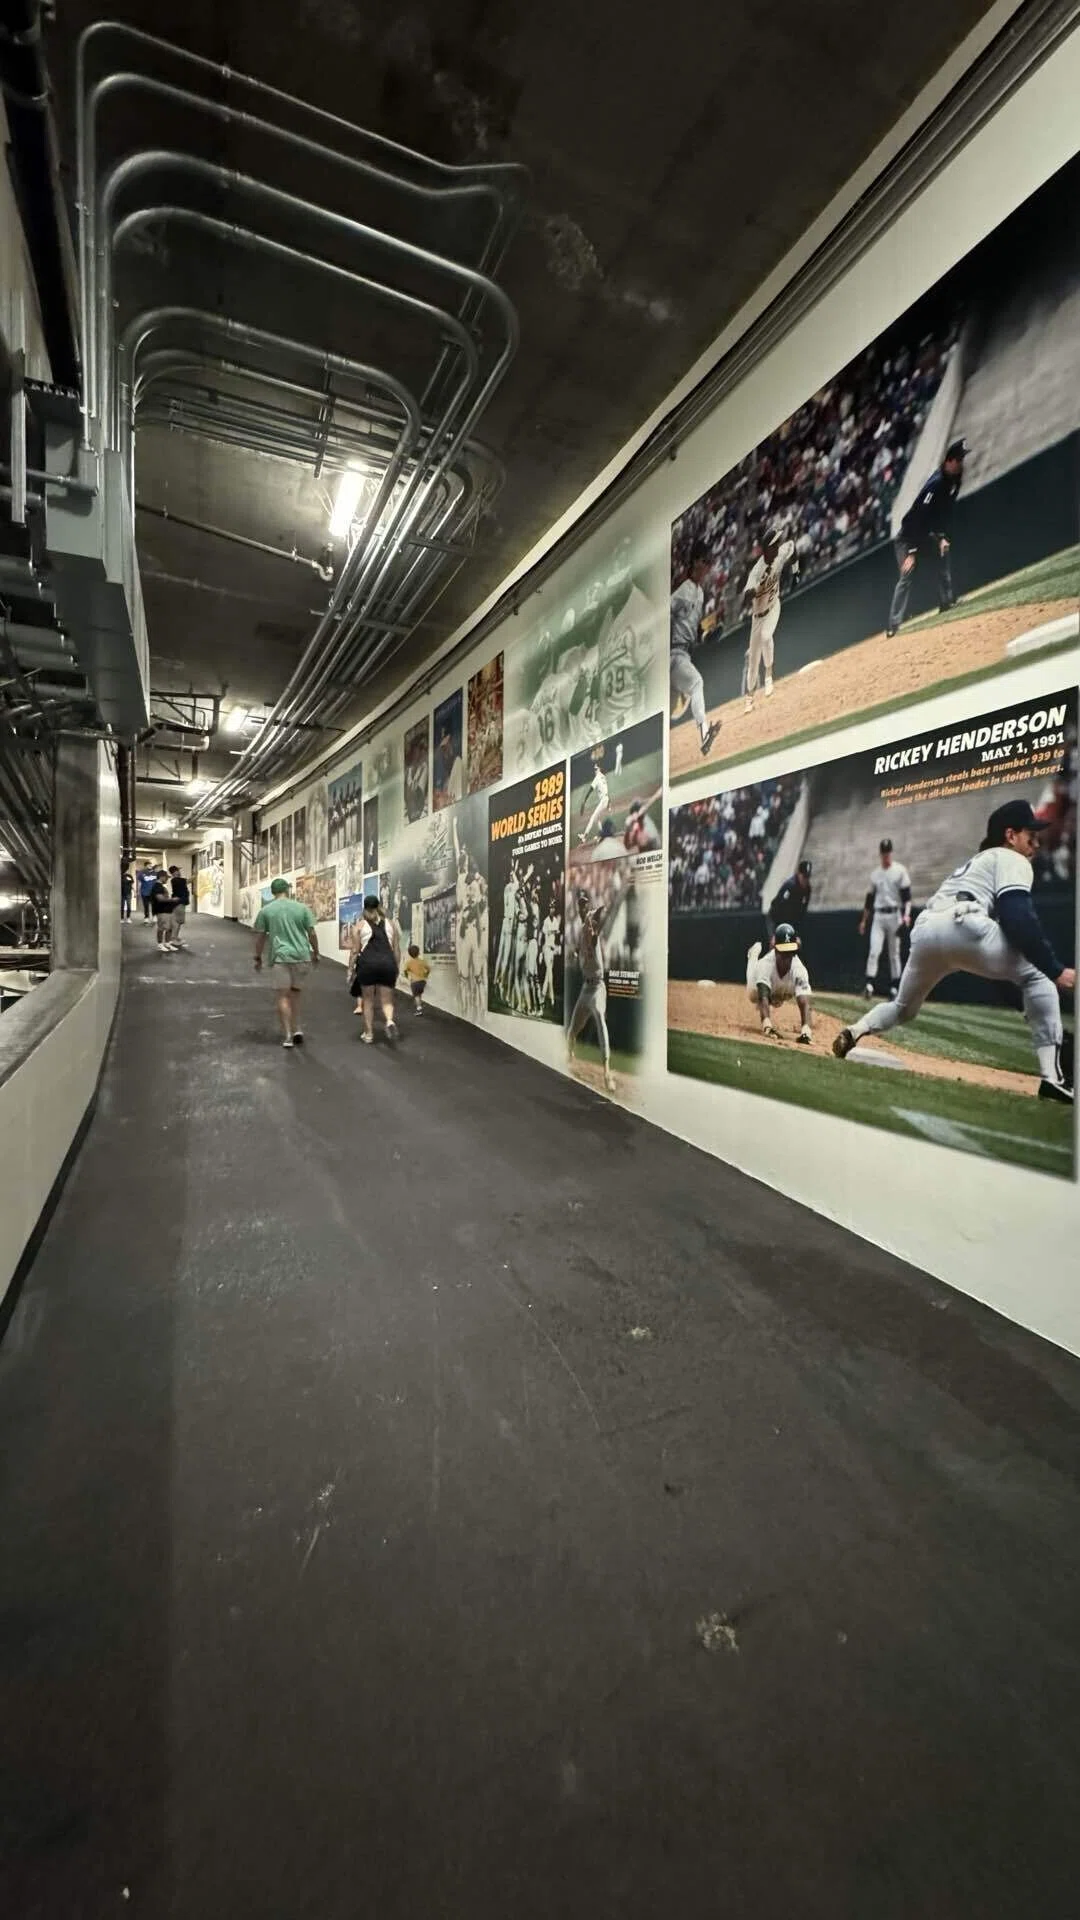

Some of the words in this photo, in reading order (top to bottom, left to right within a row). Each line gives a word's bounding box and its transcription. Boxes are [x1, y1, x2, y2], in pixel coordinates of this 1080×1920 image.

[874, 743, 934, 775] RICKEY
[935, 704, 1067, 758] HENDERSON
[981, 744, 1013, 762] MAY
[1016, 742, 1028, 754] 1,
[1032, 732, 1064, 750] 1991
[534, 771, 564, 803] 1989
[881, 786, 904, 798] Rickey
[904, 777, 944, 793] Henderson
[945, 769, 969, 783] steals
[970, 766, 991, 777] base
[993, 757, 1030, 772] number
[1031, 751, 1051, 764] 939
[1053, 749, 1065, 759] to
[961, 780, 989, 793] leader
[990, 776, 1000, 786] in
[1002, 771, 1031, 784] stolen
[1033, 764, 1064, 777] bases.
[491, 811, 526, 841] WORLD
[527, 795, 564, 829] SERIES
